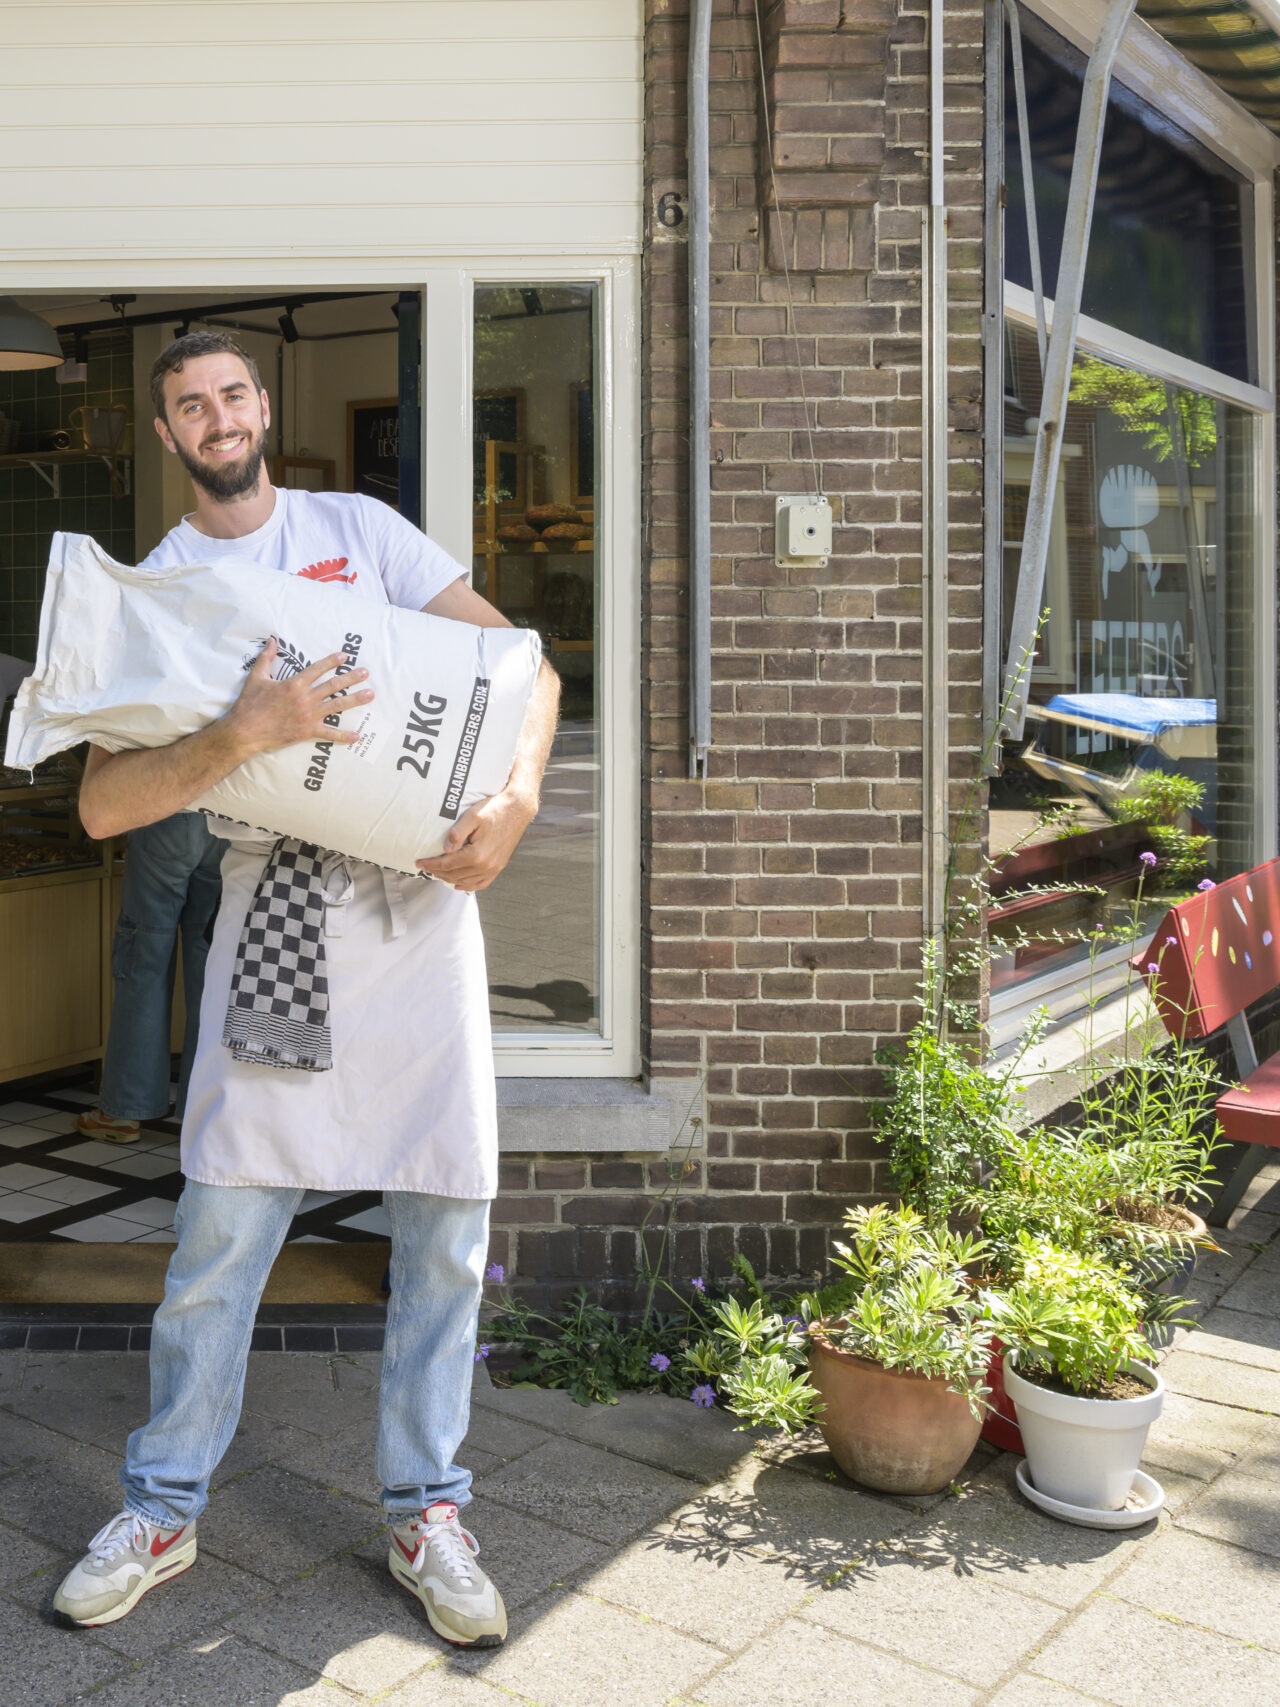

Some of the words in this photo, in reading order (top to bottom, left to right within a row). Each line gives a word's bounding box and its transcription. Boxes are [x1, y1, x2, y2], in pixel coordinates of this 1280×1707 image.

[304, 632, 363, 792] GRAABODERS
[396, 691, 448, 779] 25KG
[444, 685, 489, 811] GRAANBROEDERS.COM
[1076, 620, 1185, 755] LEFFERS
